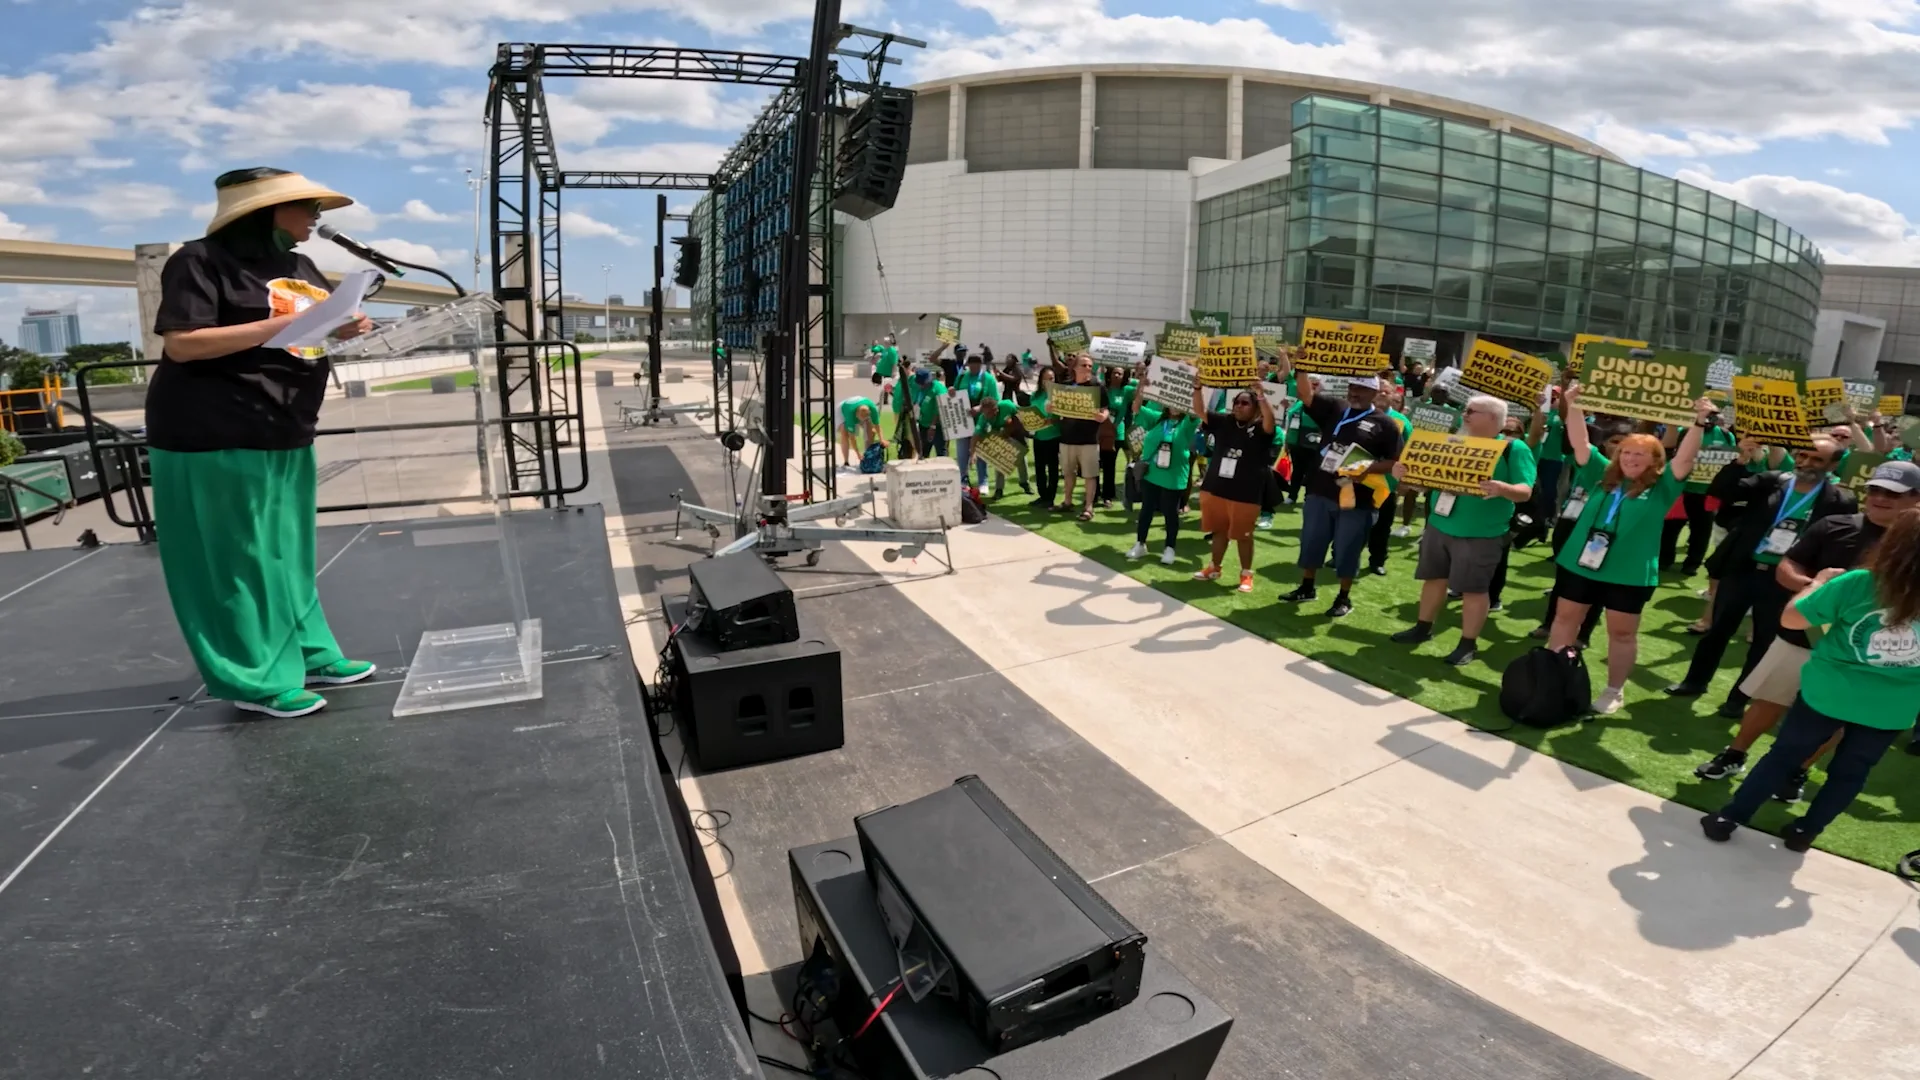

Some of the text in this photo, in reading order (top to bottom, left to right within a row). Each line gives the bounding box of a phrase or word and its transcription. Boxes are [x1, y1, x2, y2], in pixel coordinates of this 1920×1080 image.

[1167, 336, 1200, 346] PROU
[1171, 329, 1208, 338] UNION
[1305, 329, 1379, 344] ENERGIZE!
[1200, 346, 1252, 356] ERGIZE!
[1304, 340, 1375, 355] MOBILIZE!
[1200, 357, 1252, 367] OBILIZE!
[1597, 356, 1688, 380] UNION
[1160, 365, 1193, 381] WORKE
[1203, 368, 1257, 378] GANIZE!
[1750, 364, 1795, 381] UNION
[1152, 380, 1193, 397] ARE HUMA
[1463, 368, 1537, 400] ORGANIZ
[1590, 369, 1691, 396] PROUD!
[1052, 389, 1093, 401] UNION
[1579, 383, 1612, 396] SAY
[1617, 388, 1637, 400] IT
[1736, 389, 1797, 408] ENERGIZE!
[1051, 394, 1095, 408] PROUD!
[1415, 407, 1454, 422] UNITED
[1604, 403, 1661, 418] CONTRACT
[1737, 403, 1800, 422] MOBILIZE!
[1736, 416, 1810, 436] ORGANIZE!
[983, 437, 1018, 464] PROUD!
[990, 434, 1020, 456] UNION
[1410, 440, 1498, 459] ENERGIZE!
[1405, 451, 1491, 472] MOBILIZE!
[1697, 450, 1739, 460] NITED
